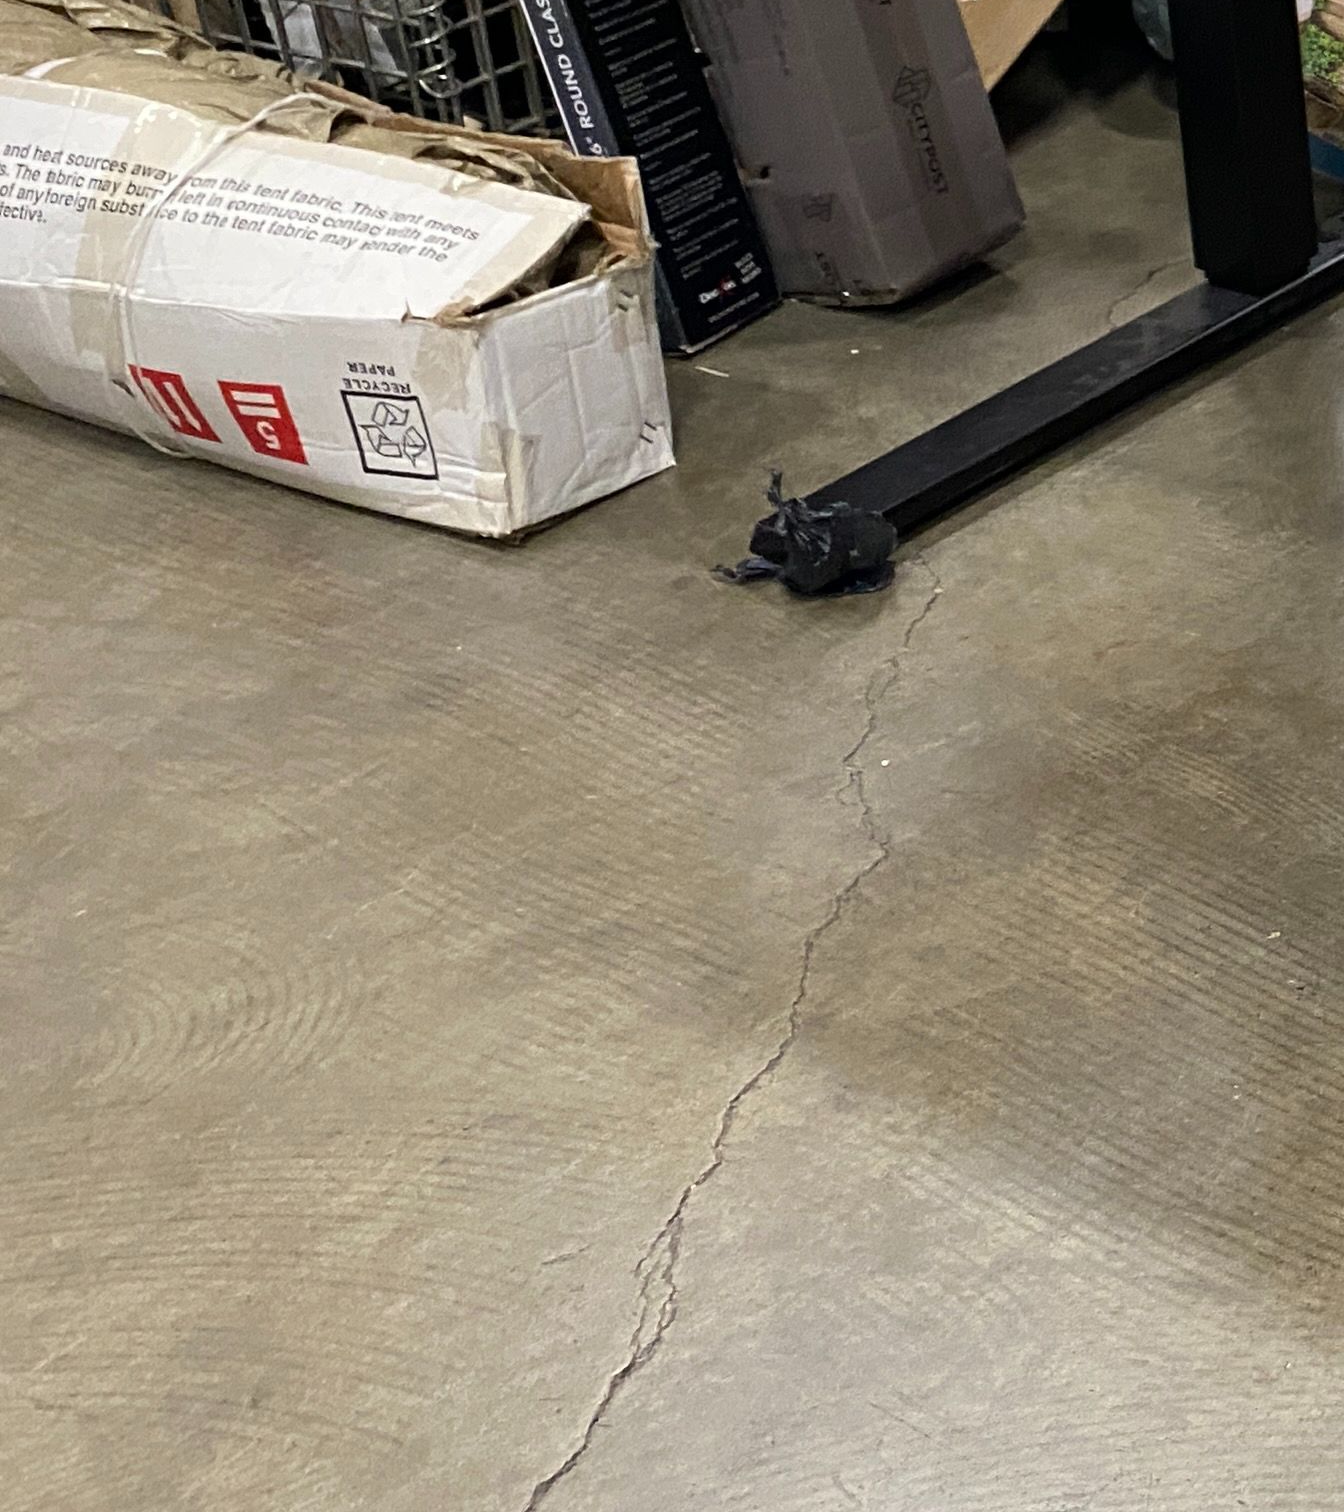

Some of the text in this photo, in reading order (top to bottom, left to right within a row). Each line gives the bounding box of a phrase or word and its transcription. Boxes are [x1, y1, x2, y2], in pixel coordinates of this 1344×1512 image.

[557, 54, 595, 129] ROUND
[3, 143, 31, 160] and
[33, 147, 62, 165] heat
[66, 154, 129, 175] sources
[131, 164, 179, 186] away
[184, 175, 218, 189] rom
[221, 177, 250, 193] this
[252, 184, 288, 202] tent
[290, 190, 344, 214] fabric.
[350, 201, 388, 220] This
[425, 217, 481, 242] meets
[16, 164, 41, 182] The
[89, 177, 123, 195] may
[177, 190, 207, 206] left
[208, 195, 223, 208] in
[226, 199, 320, 225] continuous
[424, 235, 461, 253] any
[16, 185, 46, 206] any
[45, 190, 98, 213] foreign
[181, 208, 200, 224] to
[202, 211, 228, 228] the
[231, 217, 266, 233] tent
[266, 222, 319, 242] fabric
[417, 244, 449, 264] the
[341, 377, 412, 395] RECYCLE
[346, 361, 397, 377] PAPER
